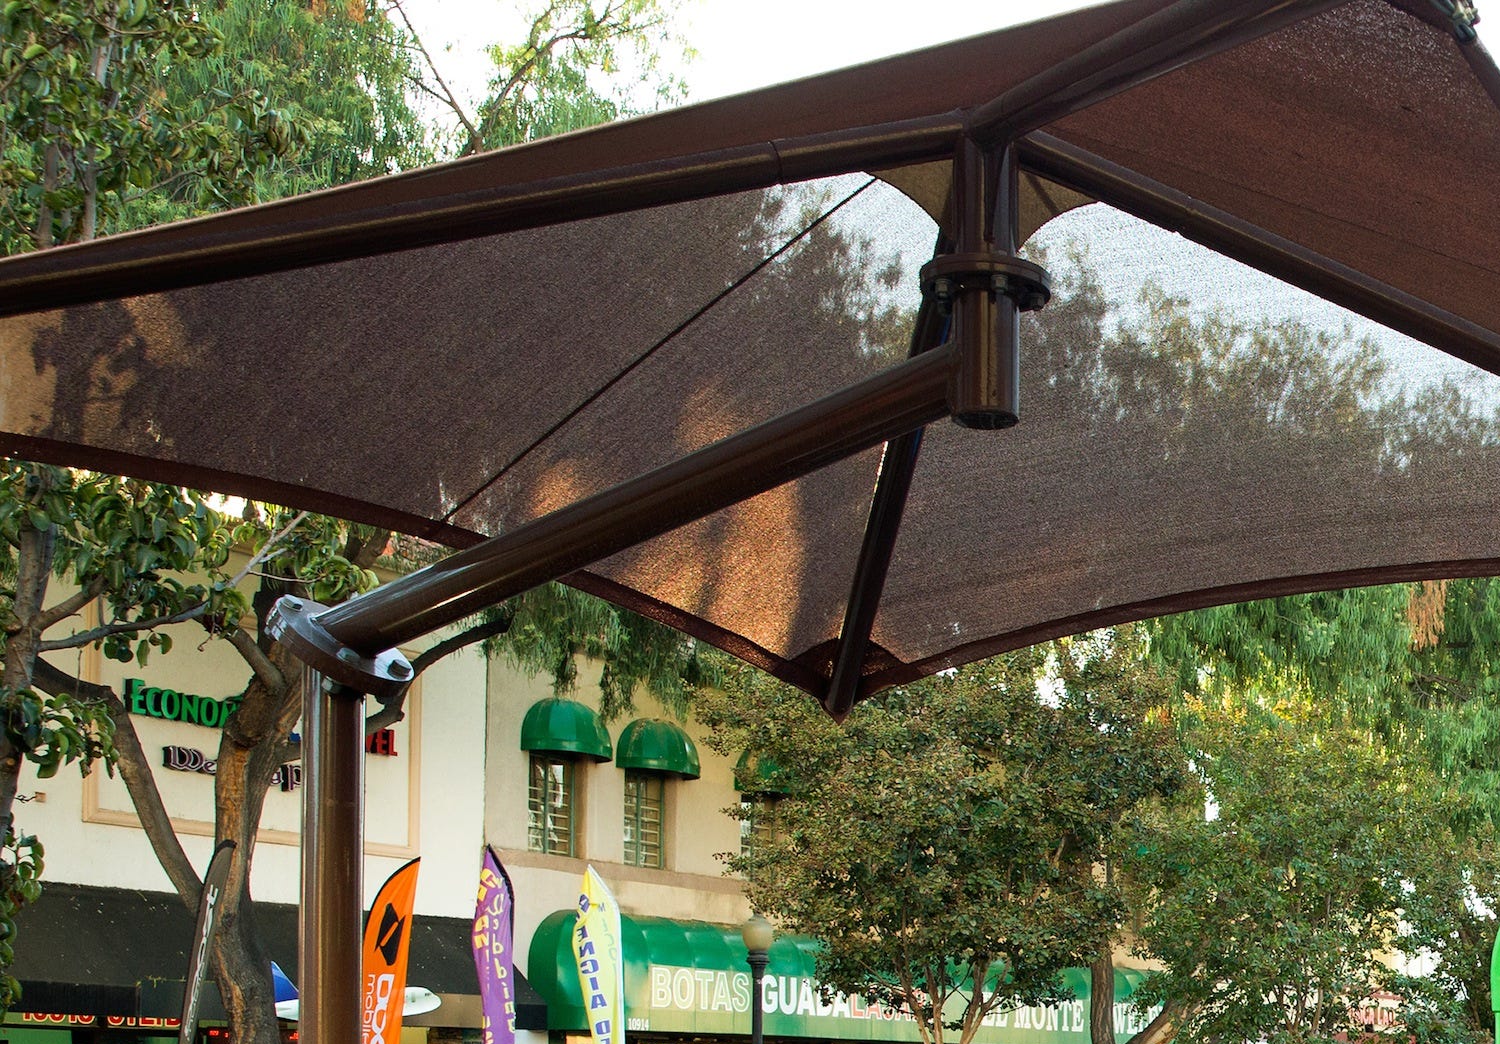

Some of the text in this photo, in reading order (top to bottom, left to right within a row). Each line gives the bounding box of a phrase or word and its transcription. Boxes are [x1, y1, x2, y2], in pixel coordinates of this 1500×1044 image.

[651, 966, 750, 1013] BOTAS
[628, 1018, 649, 1031] 10914
[1014, 998, 1084, 1033] MONTE
